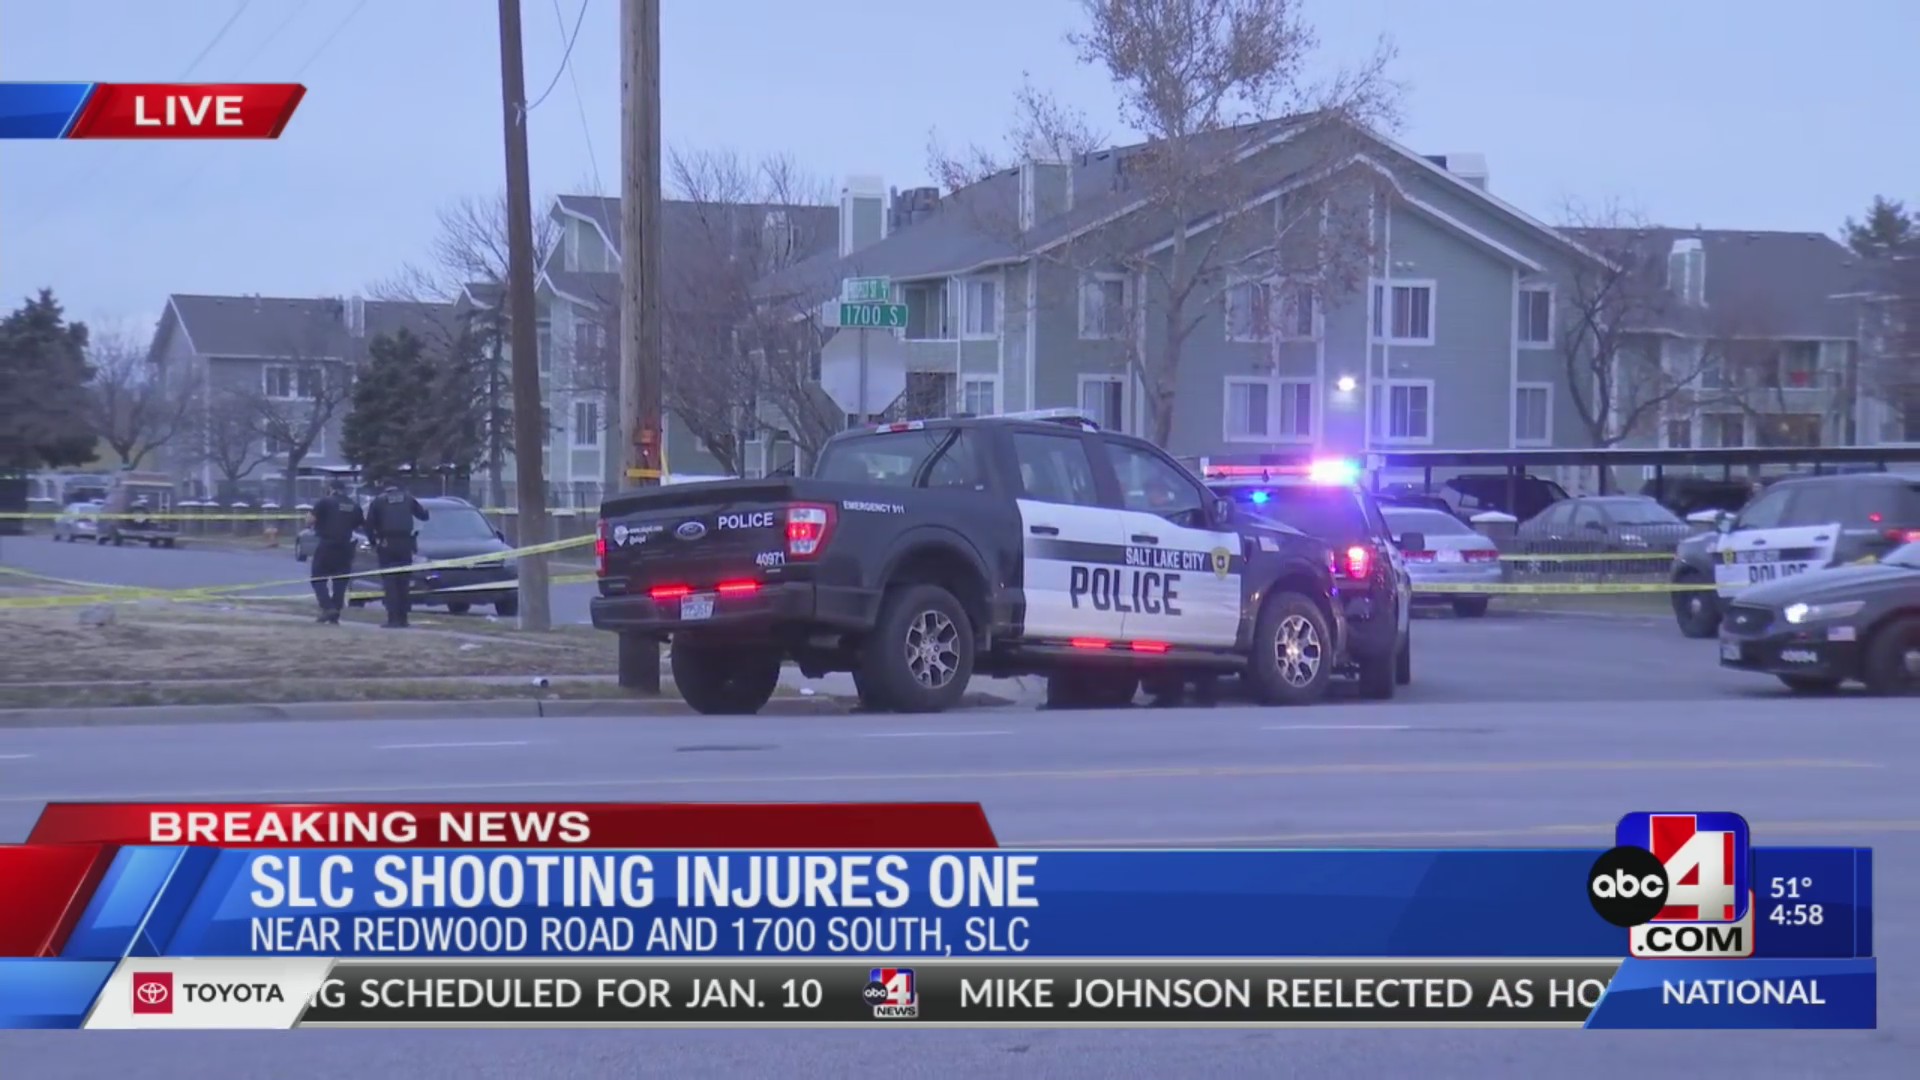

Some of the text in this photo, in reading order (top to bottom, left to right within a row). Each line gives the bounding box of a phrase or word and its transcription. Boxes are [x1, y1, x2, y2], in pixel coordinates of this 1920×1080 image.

[846, 305, 898, 325] 1700 S
[718, 512, 774, 530] POLICE
[756, 552, 786, 567] 40971
[1126, 547, 1205, 570] SALT LAKE CITY
[1070, 566, 1182, 616] POLICE
